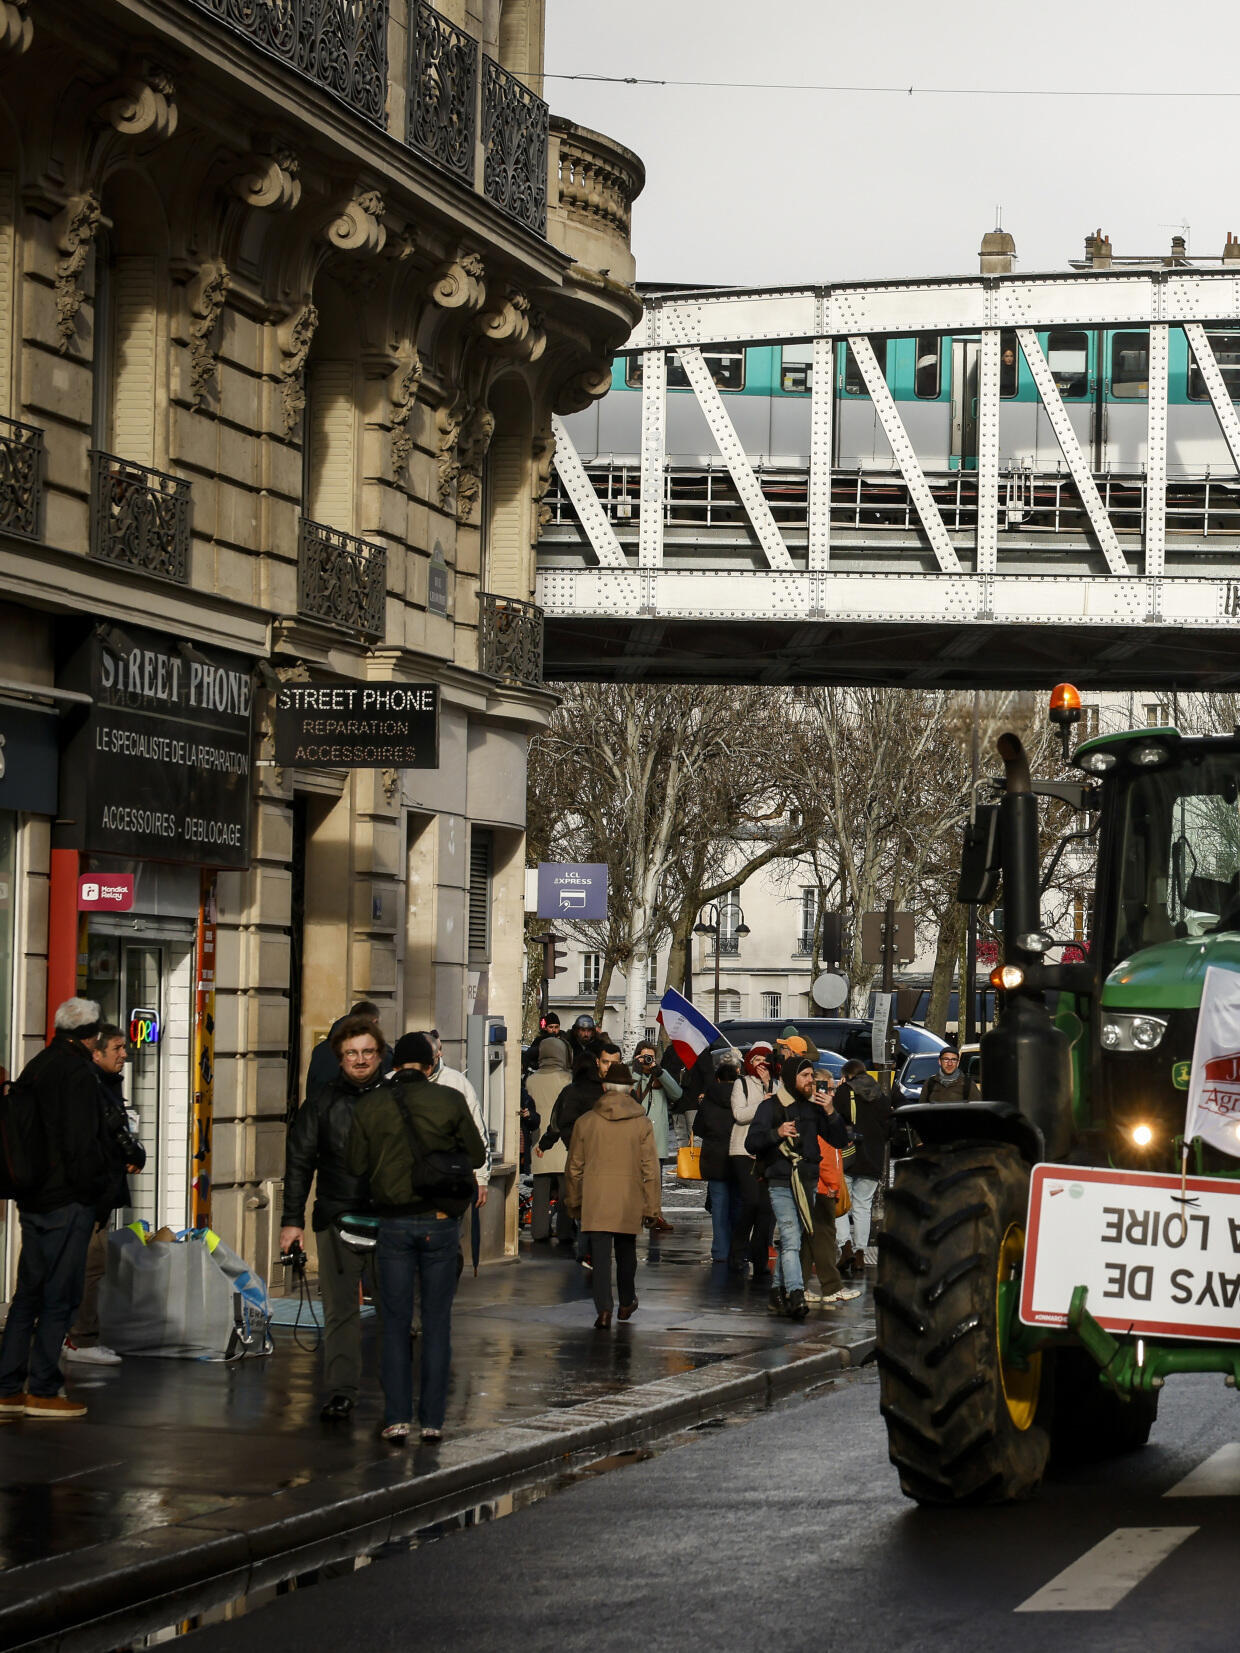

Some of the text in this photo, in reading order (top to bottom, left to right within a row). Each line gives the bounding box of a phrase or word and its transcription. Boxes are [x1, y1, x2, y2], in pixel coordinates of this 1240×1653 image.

[101, 648, 183, 702] STREET
[189, 661, 250, 717] PHONE
[278, 688, 434, 711] STREET PHONE
[302, 719, 409, 736] REPARATION
[96, 726, 249, 776] LE SPECIALISTE DE LA REPARATION
[295, 745, 416, 762] ACCESSOIRES
[102, 804, 176, 838] ACCESSOIRES
[184, 817, 241, 847] DEBLOCAGE
[1100, 1206, 1210, 1251] LOIRE
[1102, 1262, 1154, 1301] DE
